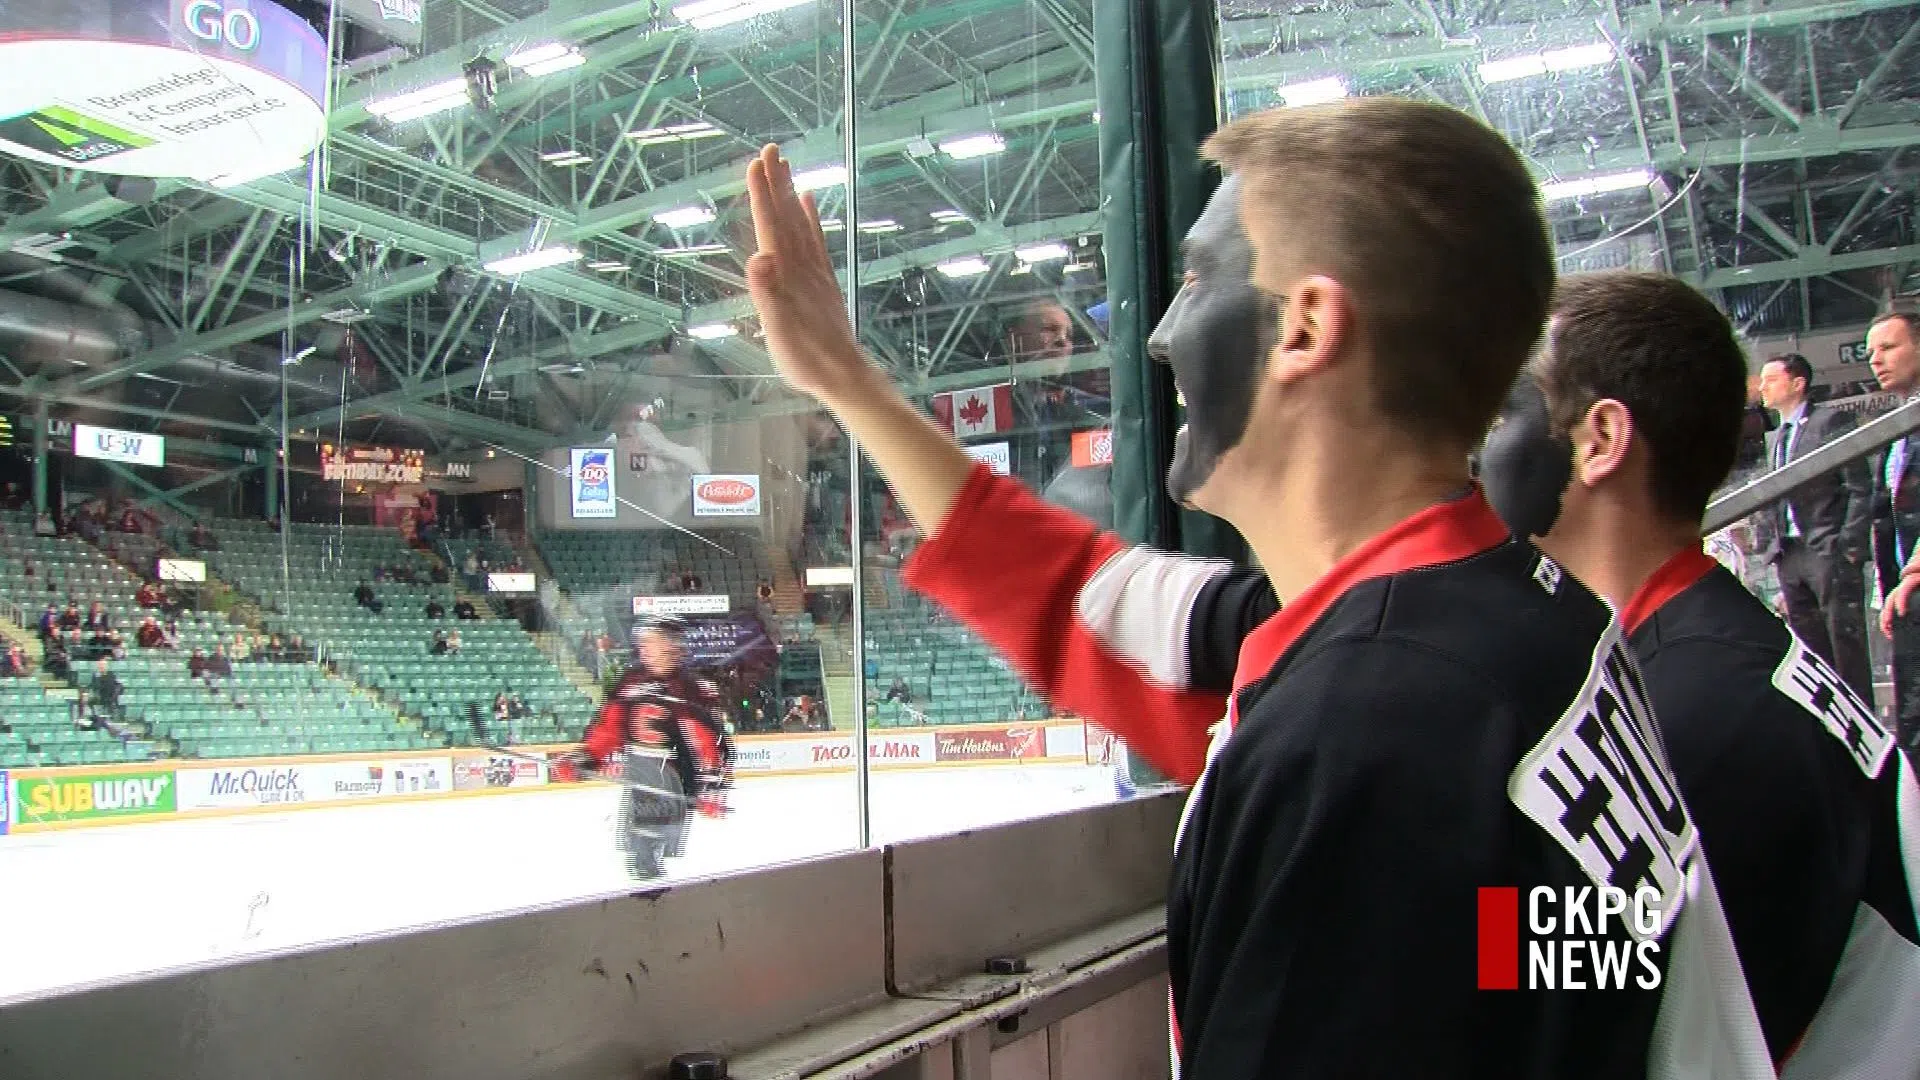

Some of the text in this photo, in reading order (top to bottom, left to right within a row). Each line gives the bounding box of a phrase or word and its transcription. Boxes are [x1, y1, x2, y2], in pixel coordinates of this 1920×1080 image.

[183, 0, 261, 50] GO
[159, 96, 288, 136] Insurance
[446, 462, 470, 478] MN
[632, 455, 645, 470] N
[583, 468, 605, 482] DQ
[812, 744, 850, 762] TACO
[883, 742, 920, 758] MAR
[31, 776, 168, 815] SUBWAY
[335, 780, 382, 793] Harmony
